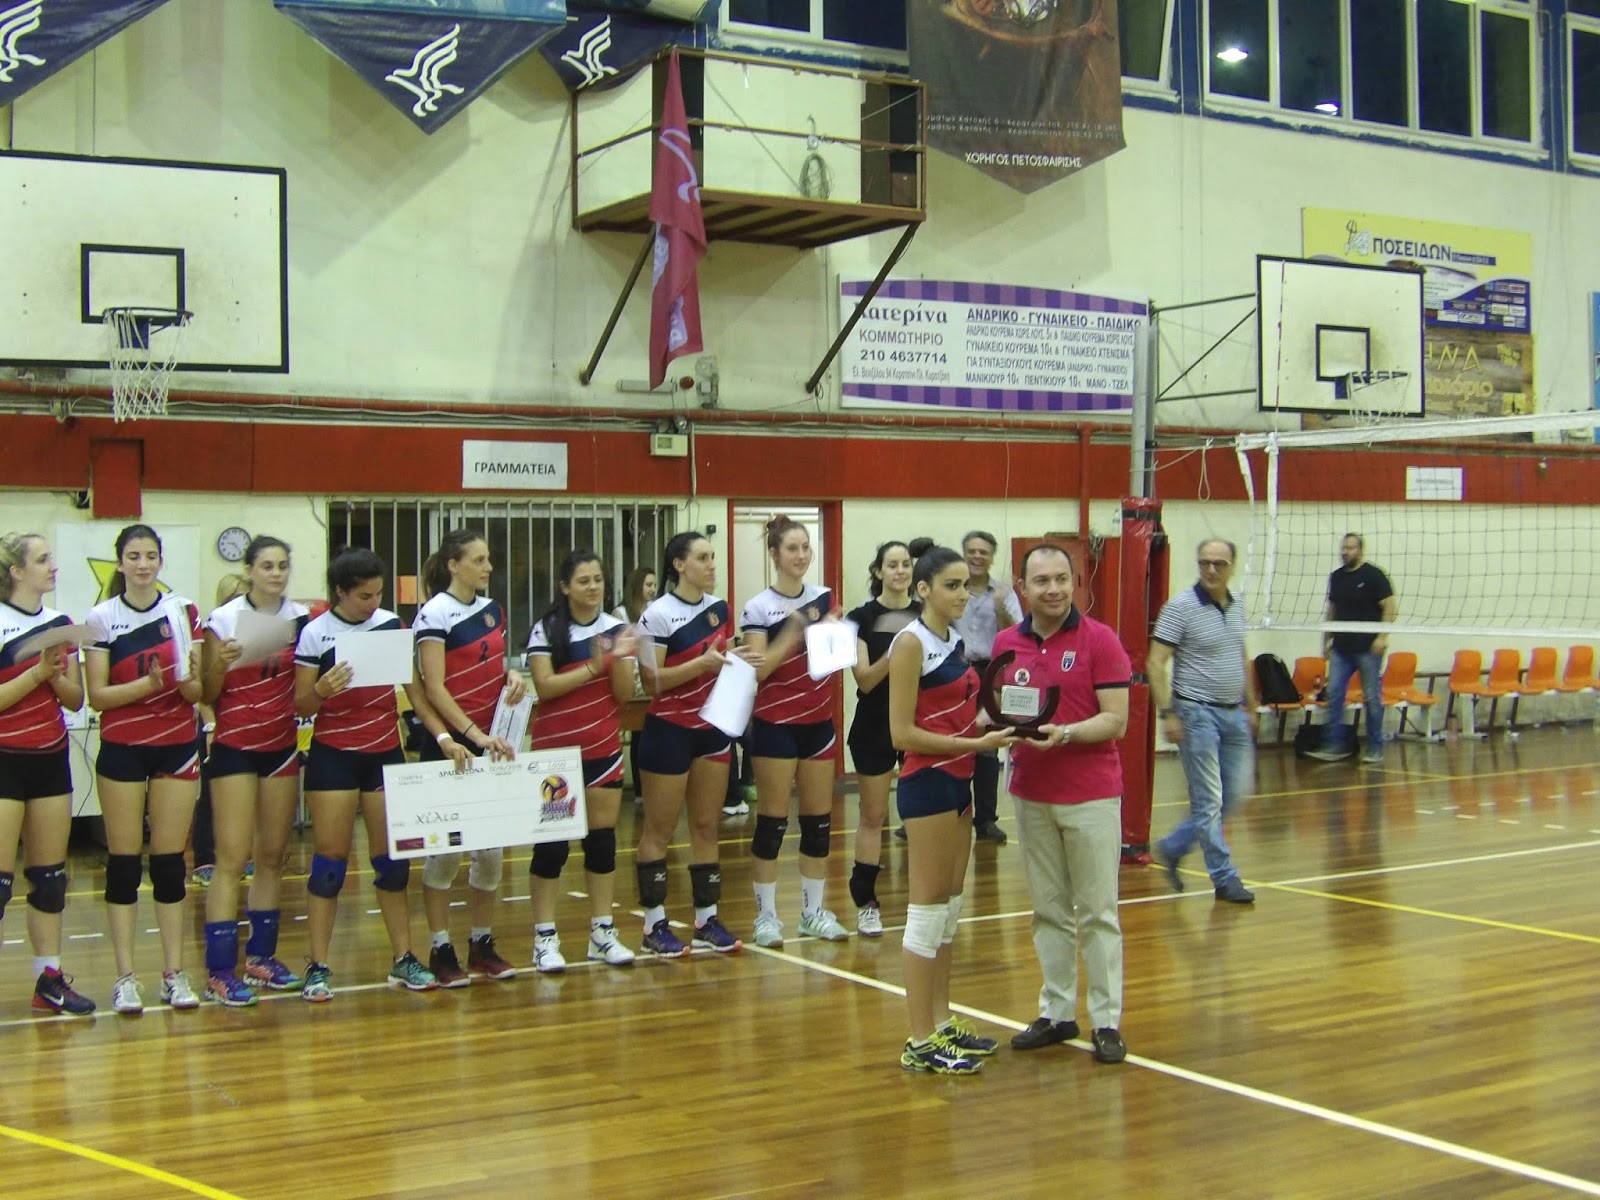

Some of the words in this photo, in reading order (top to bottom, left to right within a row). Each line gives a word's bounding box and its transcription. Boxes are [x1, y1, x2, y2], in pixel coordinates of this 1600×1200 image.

[964, 151, 1010, 166] ΧΟΡΗΓΟΣ
[1012, 153, 1082, 168] ΠΕΤΟΣΦΑΙΡΙΣΗΣ
[1373, 237, 1451, 261] ΠΟΣΕΙΔΩΝ
[967, 308, 1019, 322] ΑΝΔΡΙΚΟ
[1029, 311, 1088, 327] ΓΥΝΑΙΚΕΙΟ
[859, 329, 944, 346] ΚΟΜΜΩΤΗΡΙΟ
[860, 349, 885, 362] 210
[889, 350, 947, 365] 4637714
[966, 340, 1003, 353] ΓΥΝΑΙΚΕΙΟ
[1005, 341, 1039, 355] ΚΟΥΡΕΜΑ
[1062, 345, 1097, 358] ΓΥΝΑΙΚΕΙΟ
[966, 356, 977, 368] ΓΙΑ
[1034, 359, 1066, 371] ΚΟΥΡΕΜΑ
[965, 372, 1005, 384] ΜΑΝΙΚΙΟΥΡ
[474, 461, 556, 476] ΓΡΑΜΜΑΤΕΙΑ
